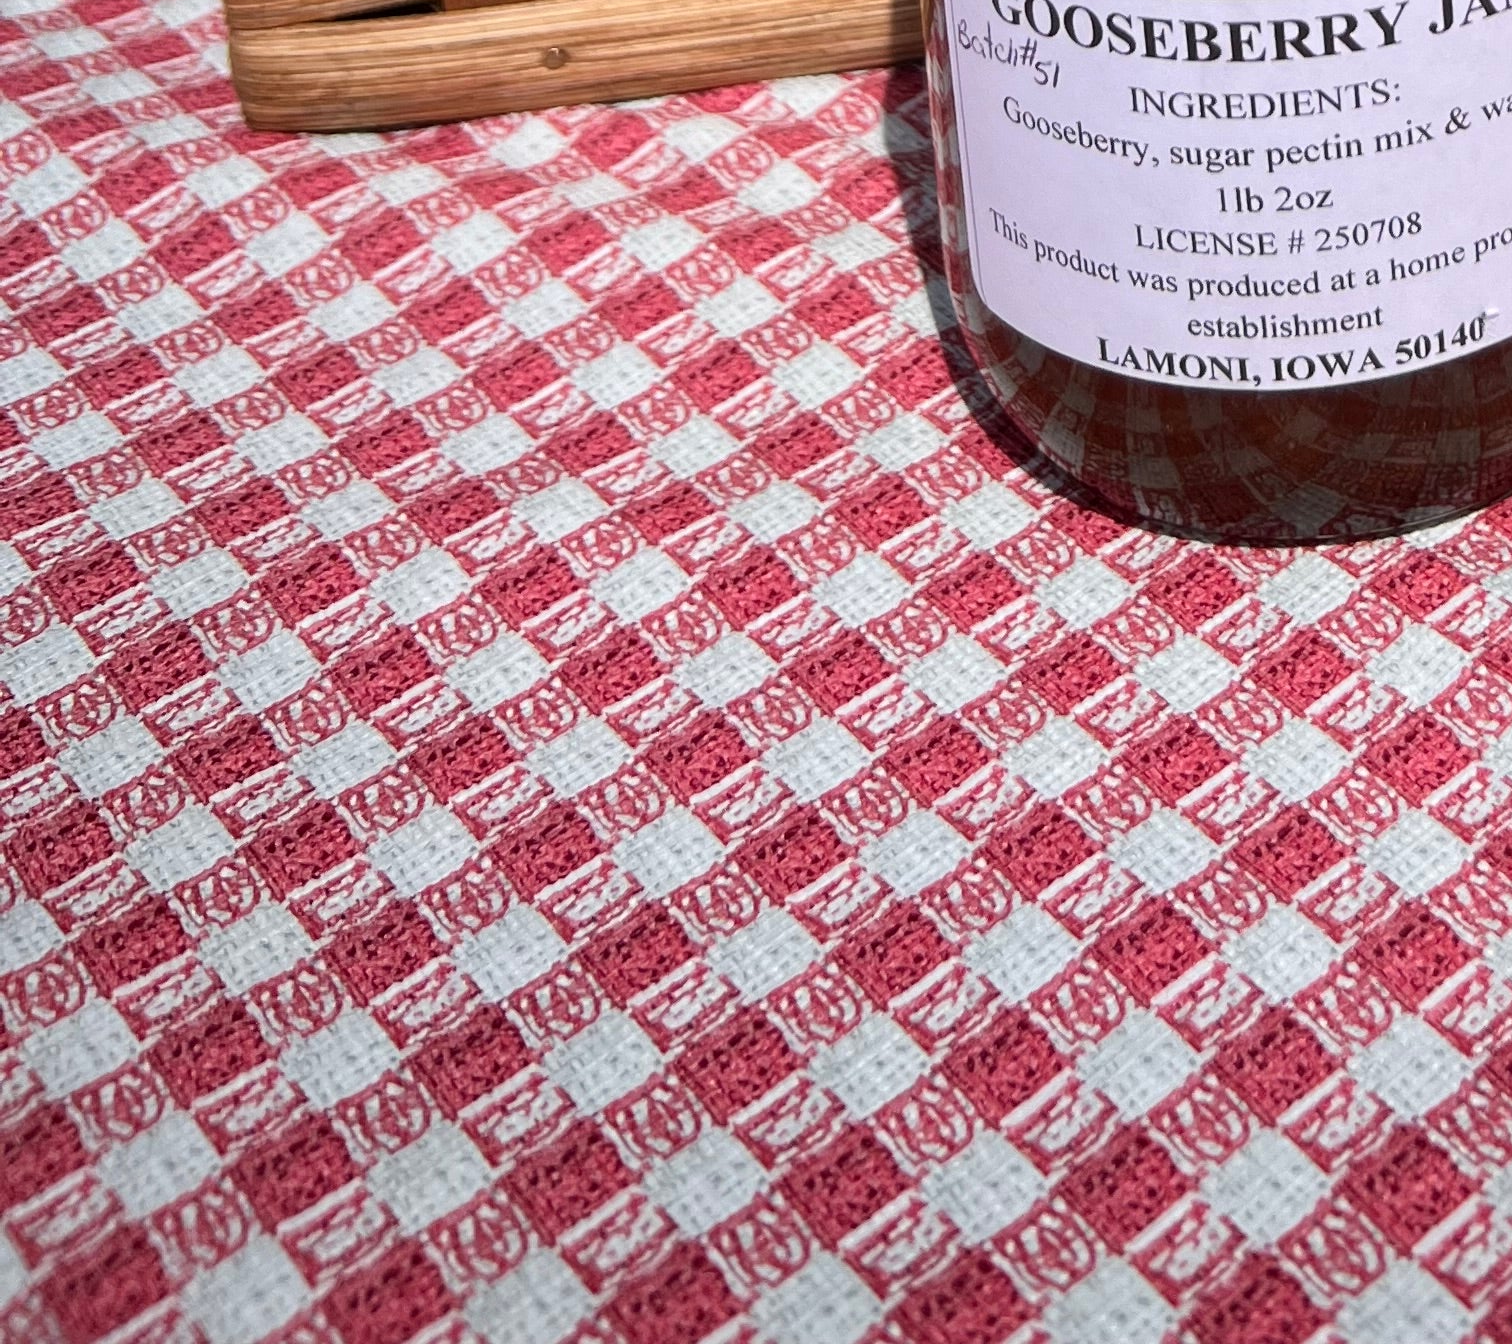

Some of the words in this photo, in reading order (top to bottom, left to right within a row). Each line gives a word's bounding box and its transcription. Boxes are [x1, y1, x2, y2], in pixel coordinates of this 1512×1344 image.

[1129, 80, 1403, 120] INGREDIENTS:
[1002, 95, 1160, 171] Gooseberry,
[1169, 139, 1252, 172] sugar
[1265, 133, 1364, 173] pectin
[1374, 119, 1433, 154] mix
[1443, 105, 1472, 135] &
[1275, 187, 1334, 212] 2oz
[988, 208, 1029, 252] This
[1034, 234, 1120, 287] product
[1127, 269, 1178, 293] was
[1187, 269, 1322, 299] produced
[1331, 268, 1358, 291] at
[1365, 268, 1382, 286] a
[1388, 244, 1466, 282] home
[1134, 223, 1279, 257] LICENSE
[1287, 229, 1306, 254] #
[1314, 211, 1423, 250] 250708
[1187, 306, 1384, 339] establishment
[1096, 336, 1262, 386] LAMONI,
[1272, 348, 1385, 382] IOWA
[1395, 314, 1488, 367] 50140
